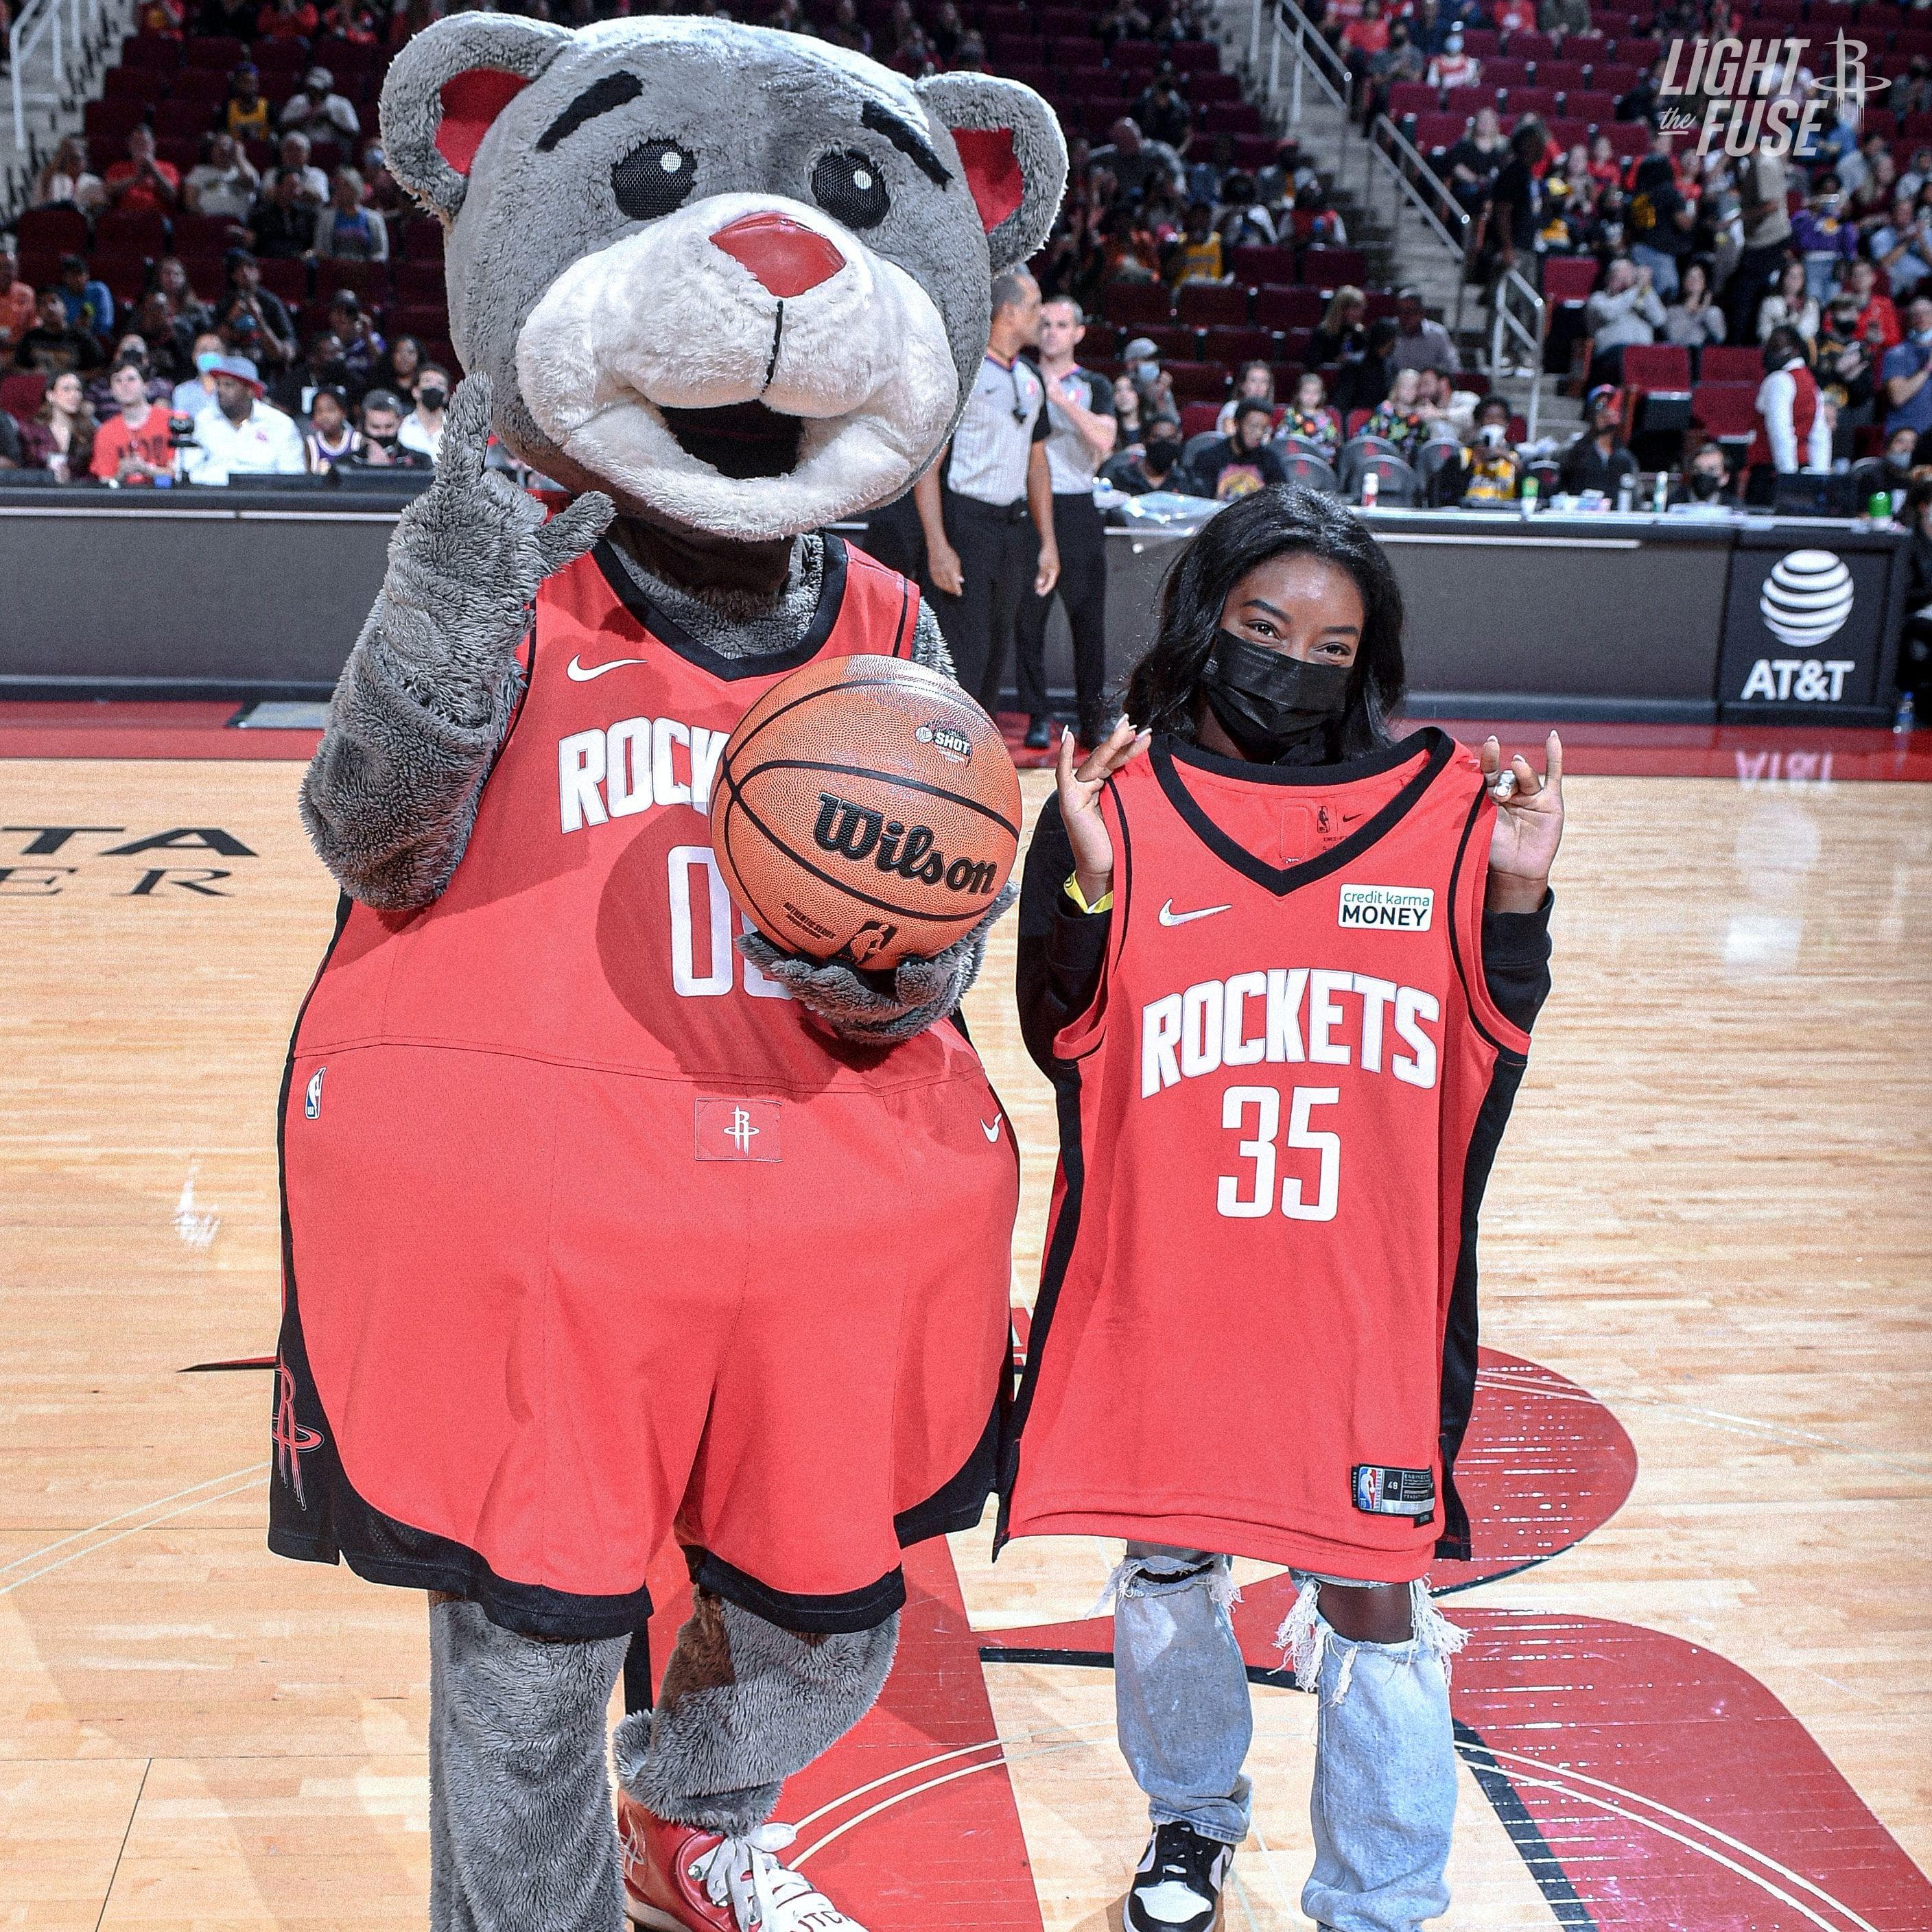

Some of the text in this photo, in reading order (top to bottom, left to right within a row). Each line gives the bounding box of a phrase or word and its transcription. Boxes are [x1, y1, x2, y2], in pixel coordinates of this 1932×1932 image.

[1740, 659, 1855, 702] AT&T
[934, 732, 969, 754] SHOT
[558, 716, 731, 834] ROCK
[813, 792, 998, 895] Wilson
[1342, 904, 1428, 926] MONEY
[1343, 891, 1430, 906] credit karma
[1141, 967, 1439, 1099] ROCKETS
[1216, 1085, 1341, 1222] 35
[1387, 1481, 1398, 1489] 48
